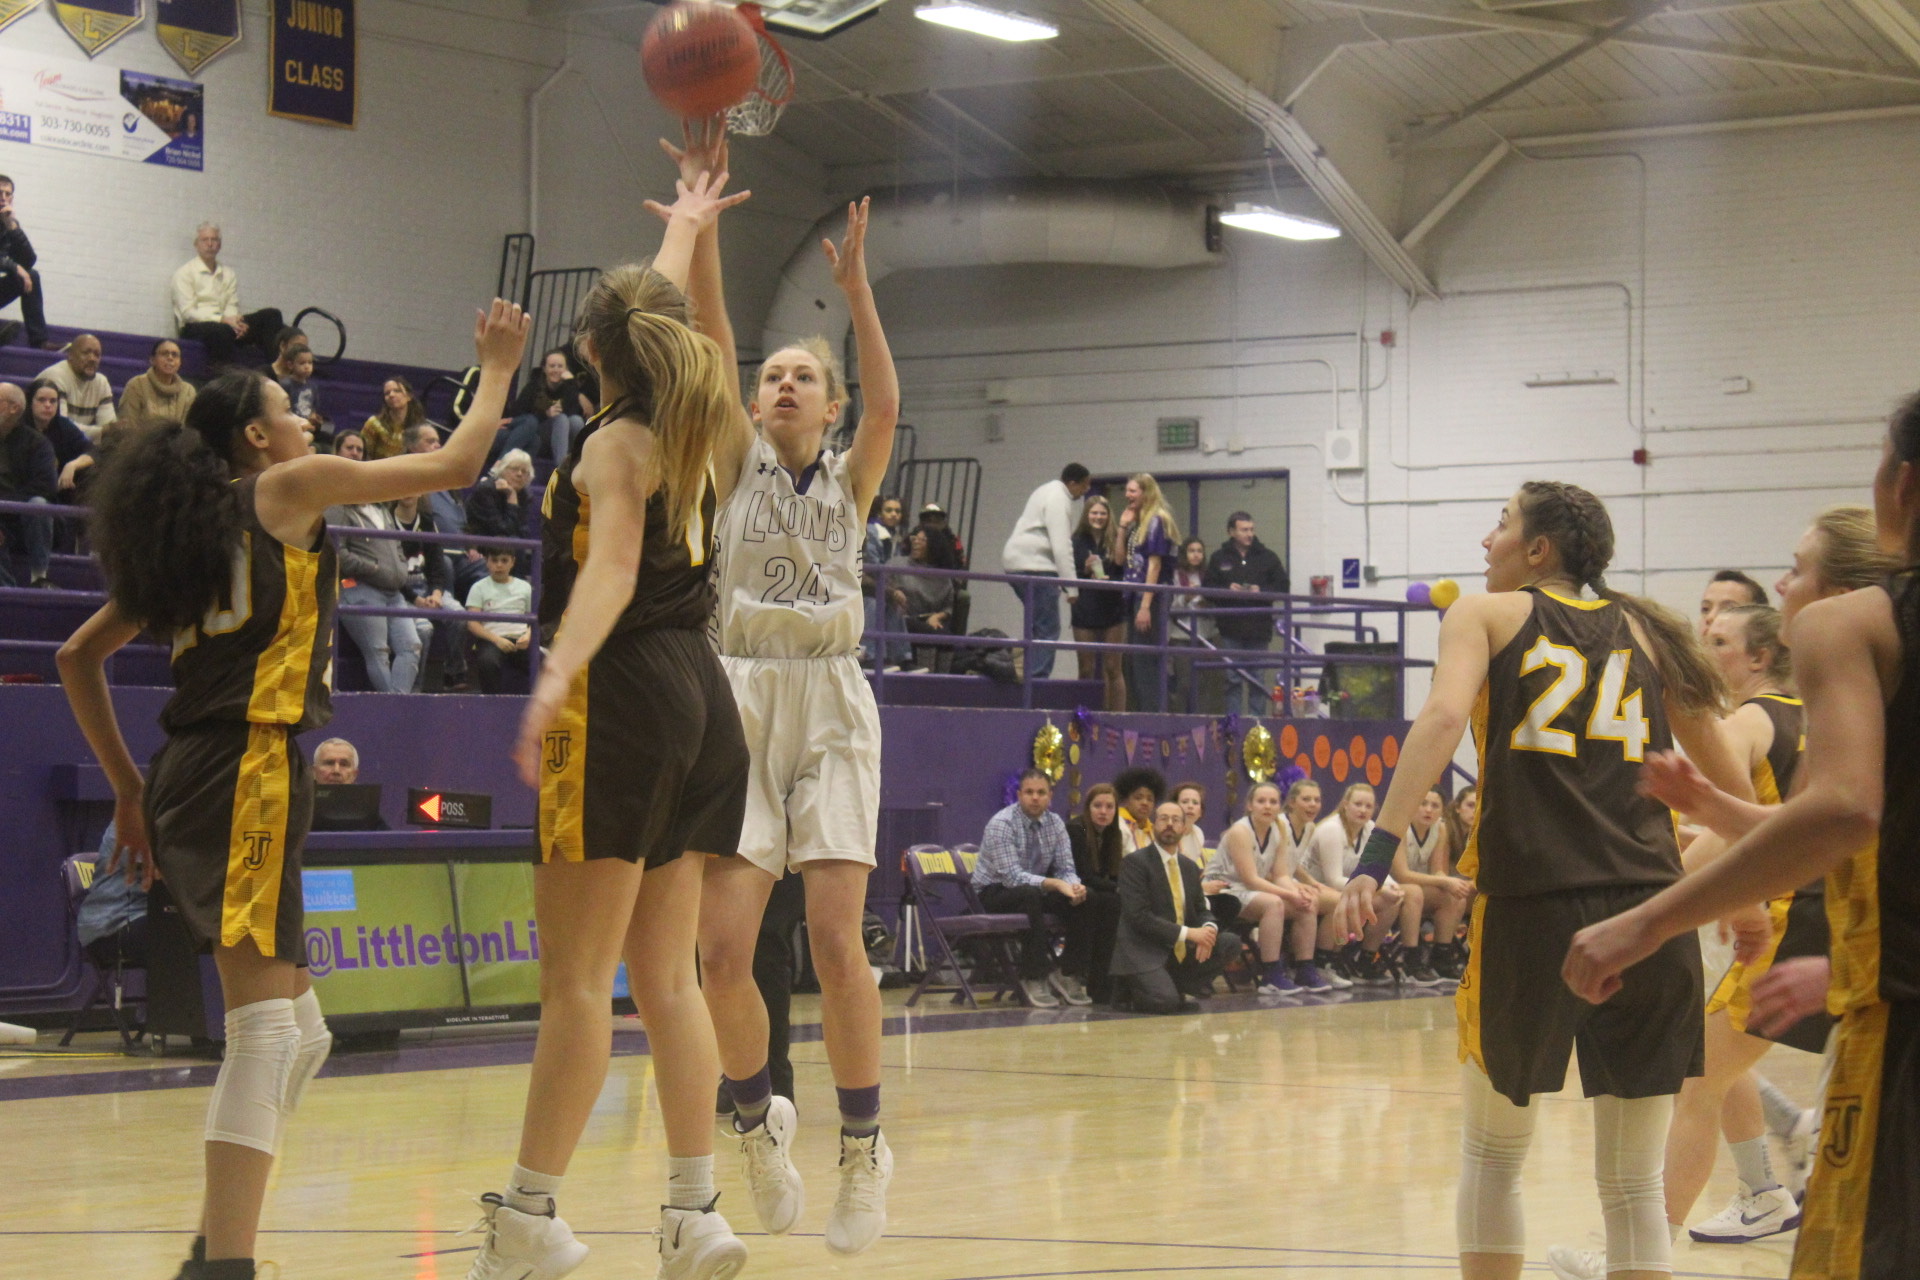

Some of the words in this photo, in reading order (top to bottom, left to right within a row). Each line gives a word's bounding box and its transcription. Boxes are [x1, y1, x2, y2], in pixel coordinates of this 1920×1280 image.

[287, 0, 343, 38] JUNIOR
[285, 60, 344, 91] CLASS
[41, 115, 111, 138] 303-730-0055
[743, 490, 847, 552] LIONS
[760, 556, 830, 608] 24
[1509, 634, 1651, 763] 24
[441, 801, 466, 816] POSS.
